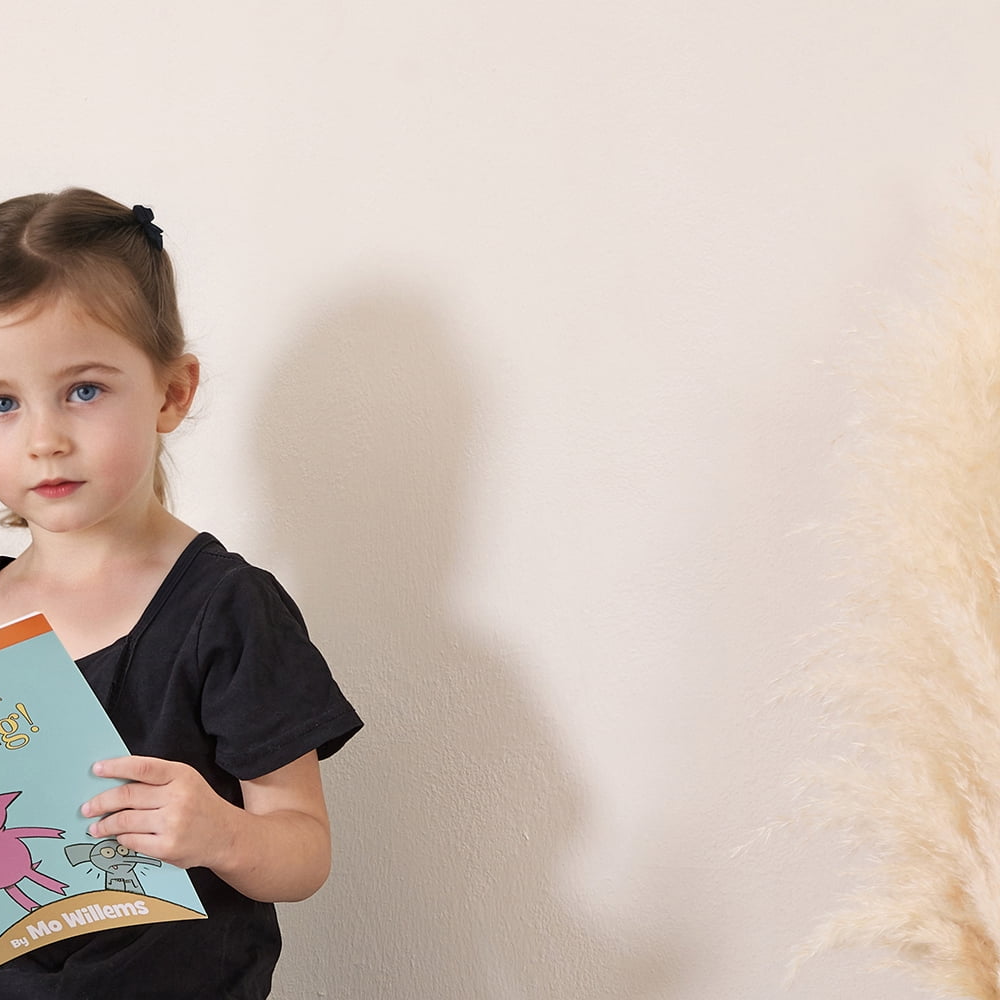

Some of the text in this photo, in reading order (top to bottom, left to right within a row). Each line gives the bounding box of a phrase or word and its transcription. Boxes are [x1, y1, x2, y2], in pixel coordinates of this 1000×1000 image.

[10, 900, 149, 949] By Mo Willems
